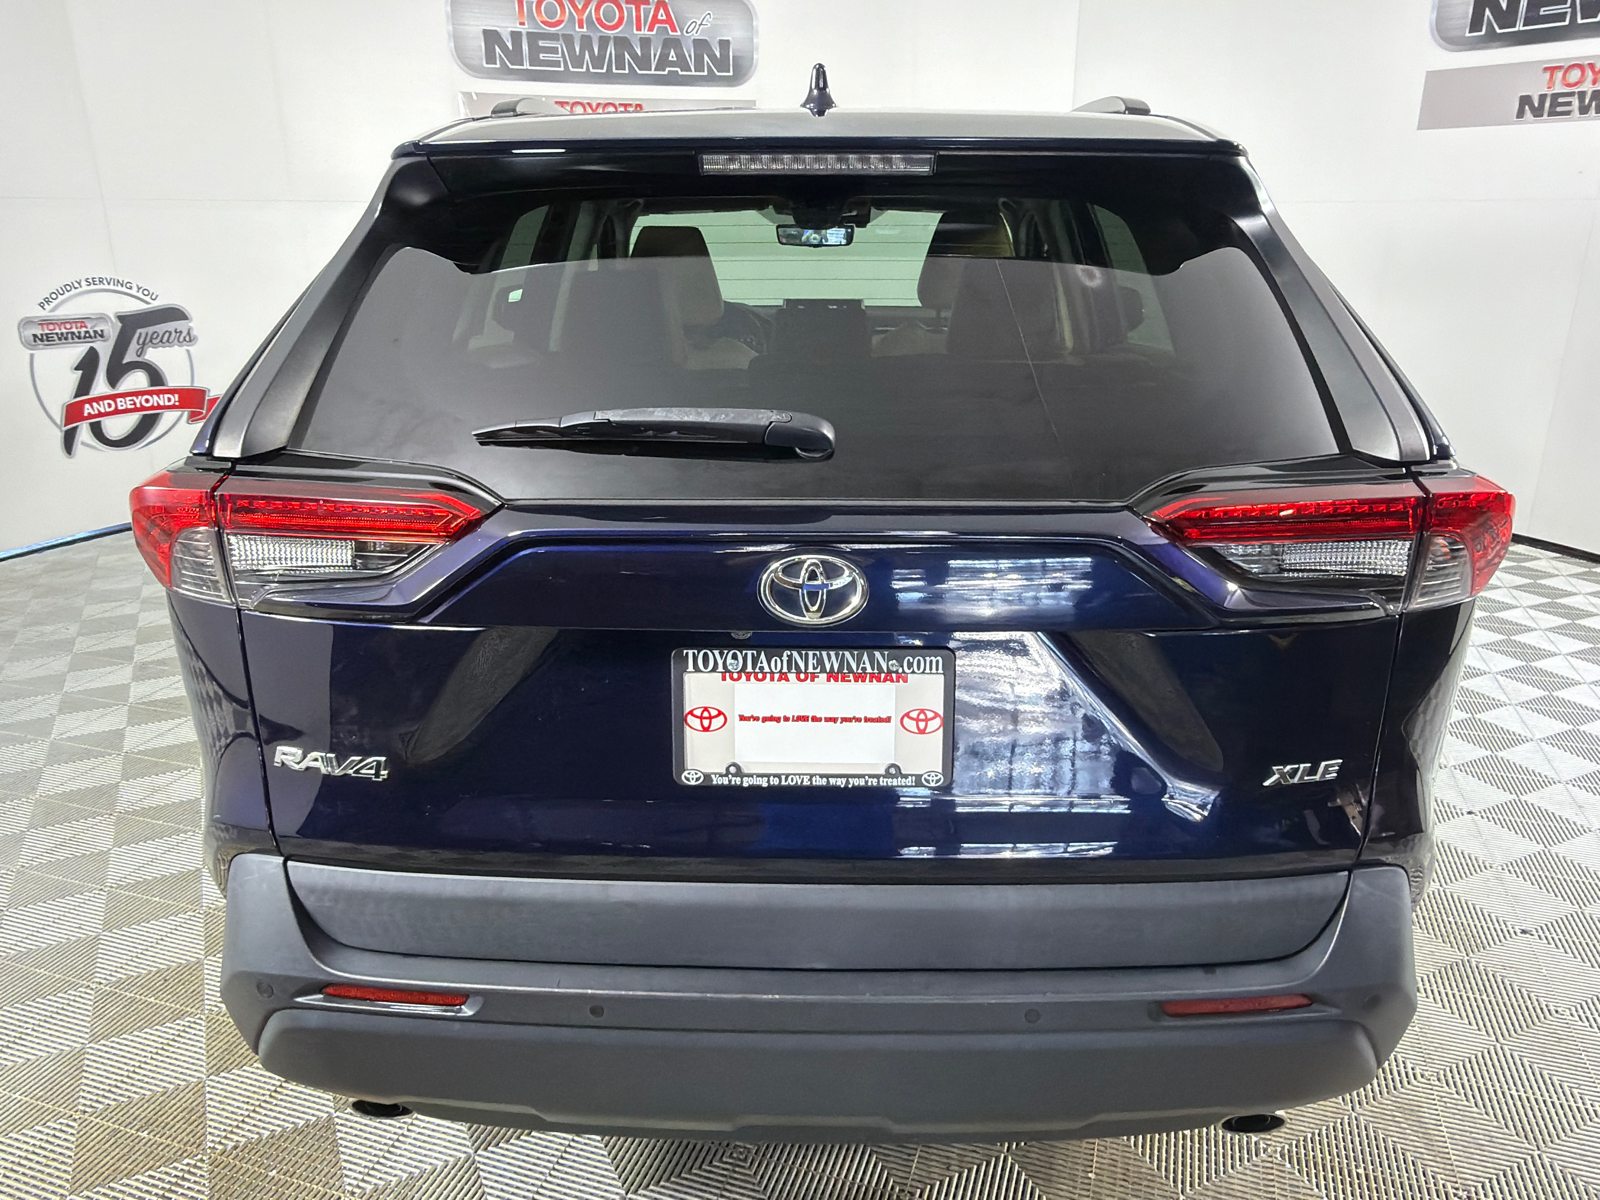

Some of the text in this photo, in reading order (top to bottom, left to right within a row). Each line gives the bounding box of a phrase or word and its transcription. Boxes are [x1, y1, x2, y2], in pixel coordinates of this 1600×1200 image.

[514, 0, 712, 35] TOYOTA of
[481, 28, 734, 76] NEWNAN
[38, 276, 159, 311] PROUDLY SERVING YOU
[32, 329, 105, 343] NEWNAN
[38, 320, 88, 332] TOYOTA
[136, 326, 195, 357] years
[62, 306, 190, 457] 15
[84, 394, 180, 417] AND BEYOND!
[274, 745, 389, 781] RAV4
[1262, 758, 1343, 787] XLE
[711, 774, 915, 788] You're going to LOVE the way you're treated!
